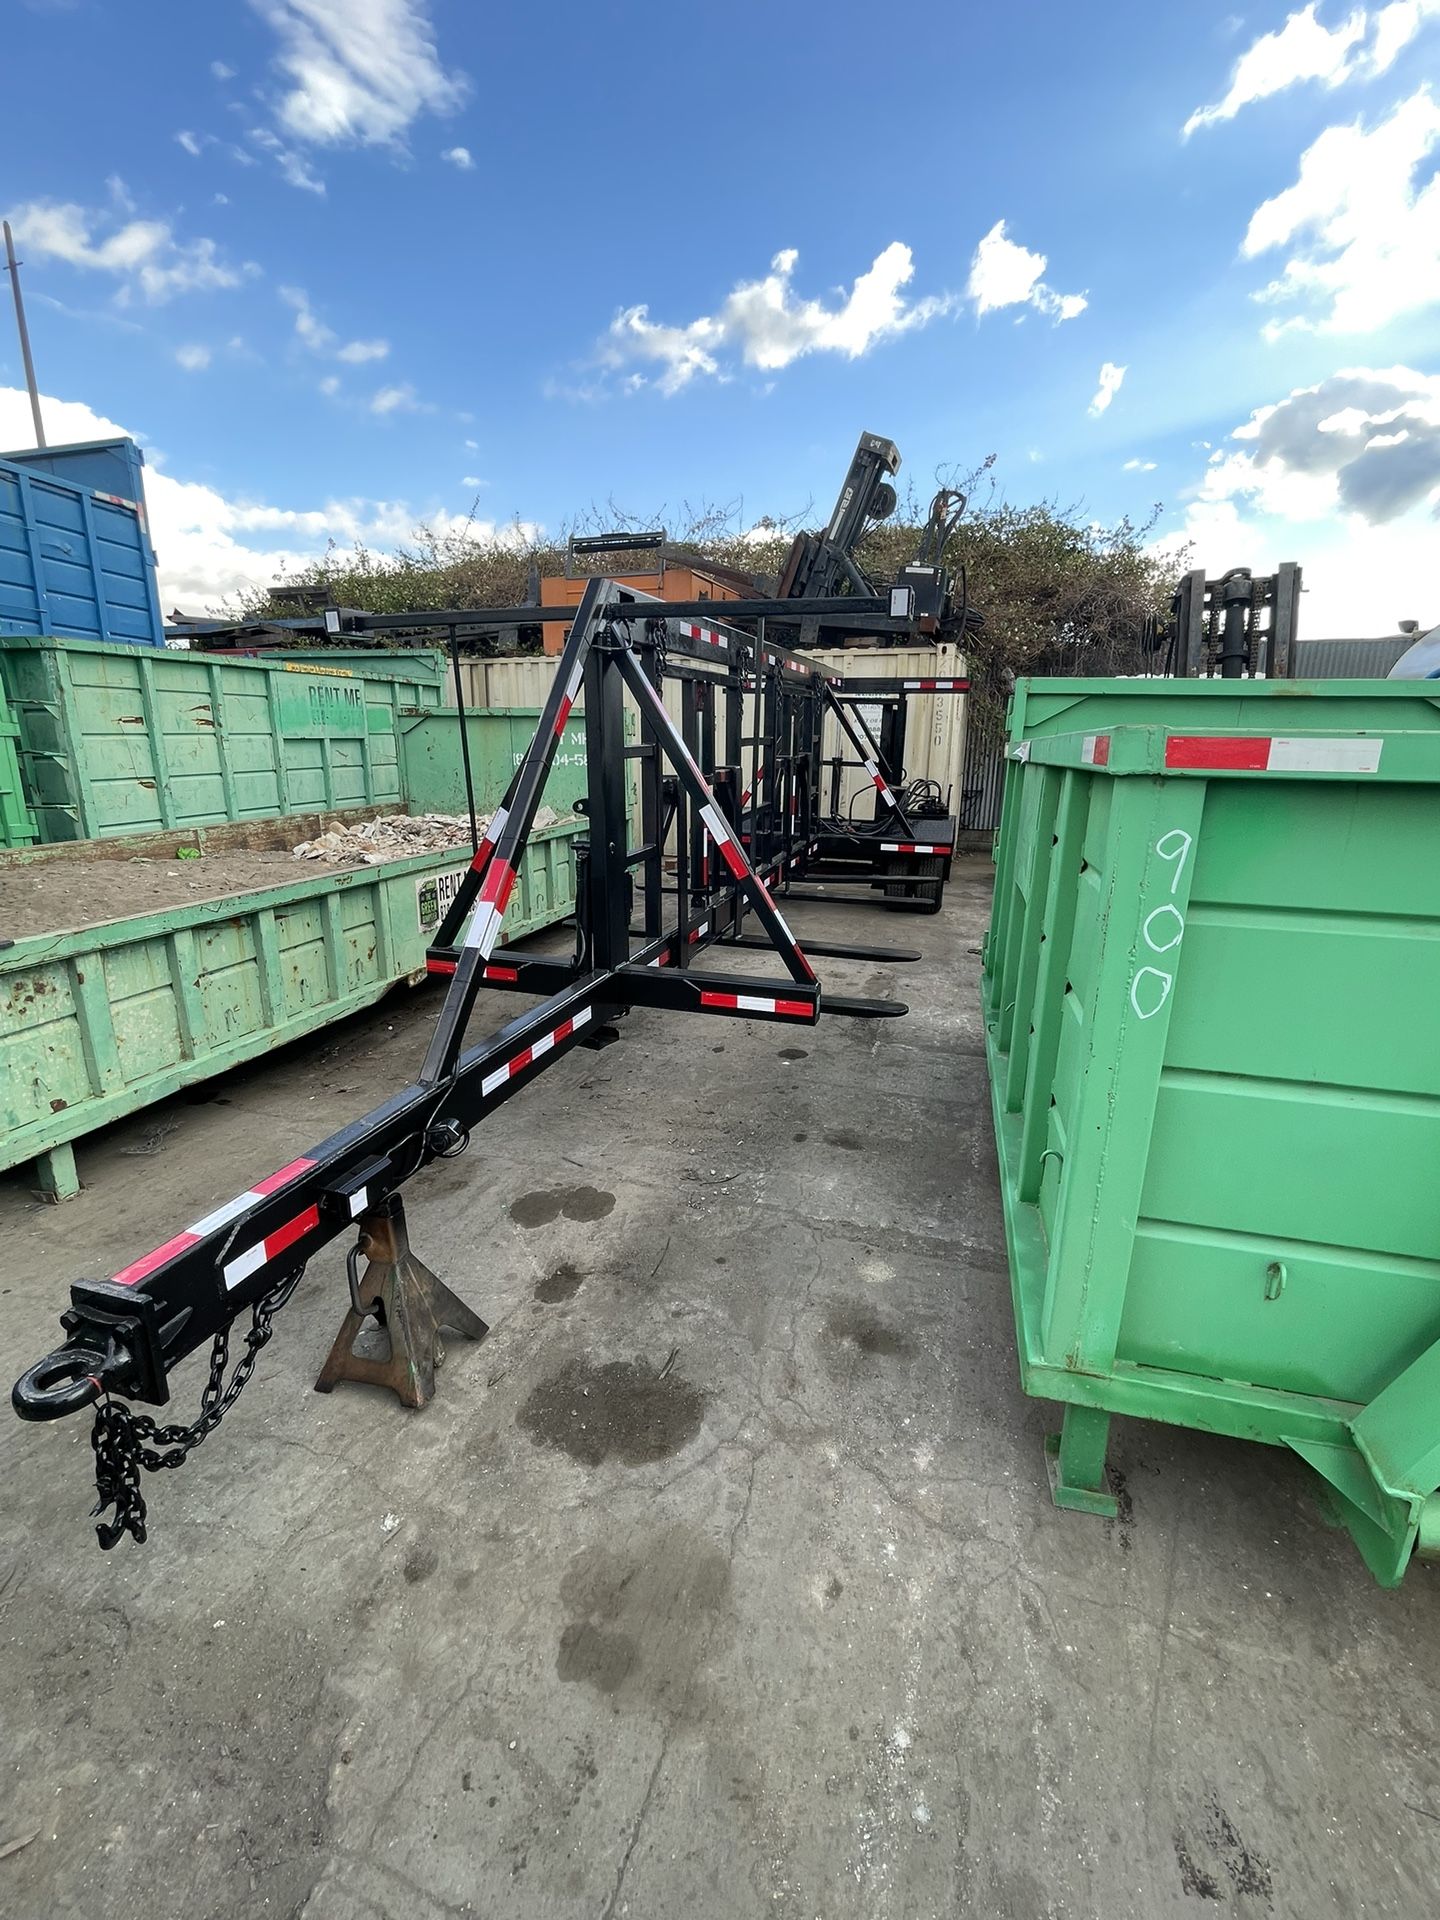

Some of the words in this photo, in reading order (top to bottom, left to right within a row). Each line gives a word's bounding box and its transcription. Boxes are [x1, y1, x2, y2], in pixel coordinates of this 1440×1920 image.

[308, 685, 340, 707] RENT
[438, 872, 461, 901] RENT
[1131, 829, 1193, 1020] 900
